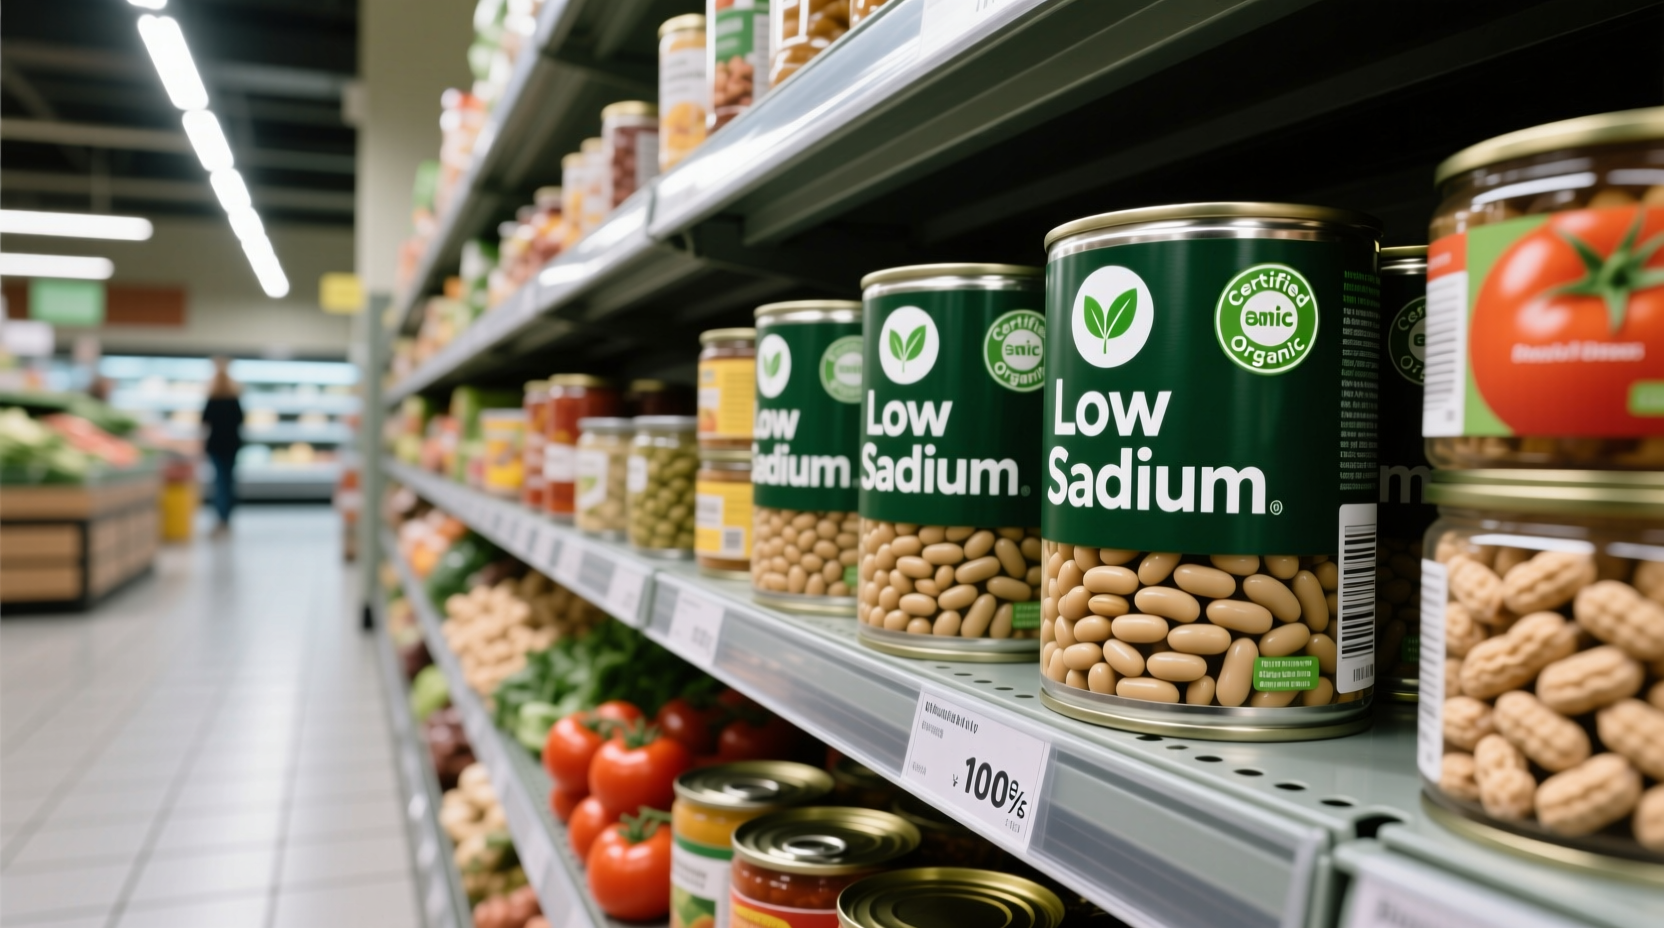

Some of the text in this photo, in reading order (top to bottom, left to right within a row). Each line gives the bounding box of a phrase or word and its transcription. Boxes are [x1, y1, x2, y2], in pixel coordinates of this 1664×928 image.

[1228, 270, 1311, 308] Certified
[992, 314, 1046, 341] Certifie
[1230, 335, 1305, 367] Organic
[994, 361, 1045, 387] Organi
[866, 389, 953, 437] Low
[1054, 378, 1172, 437] Low
